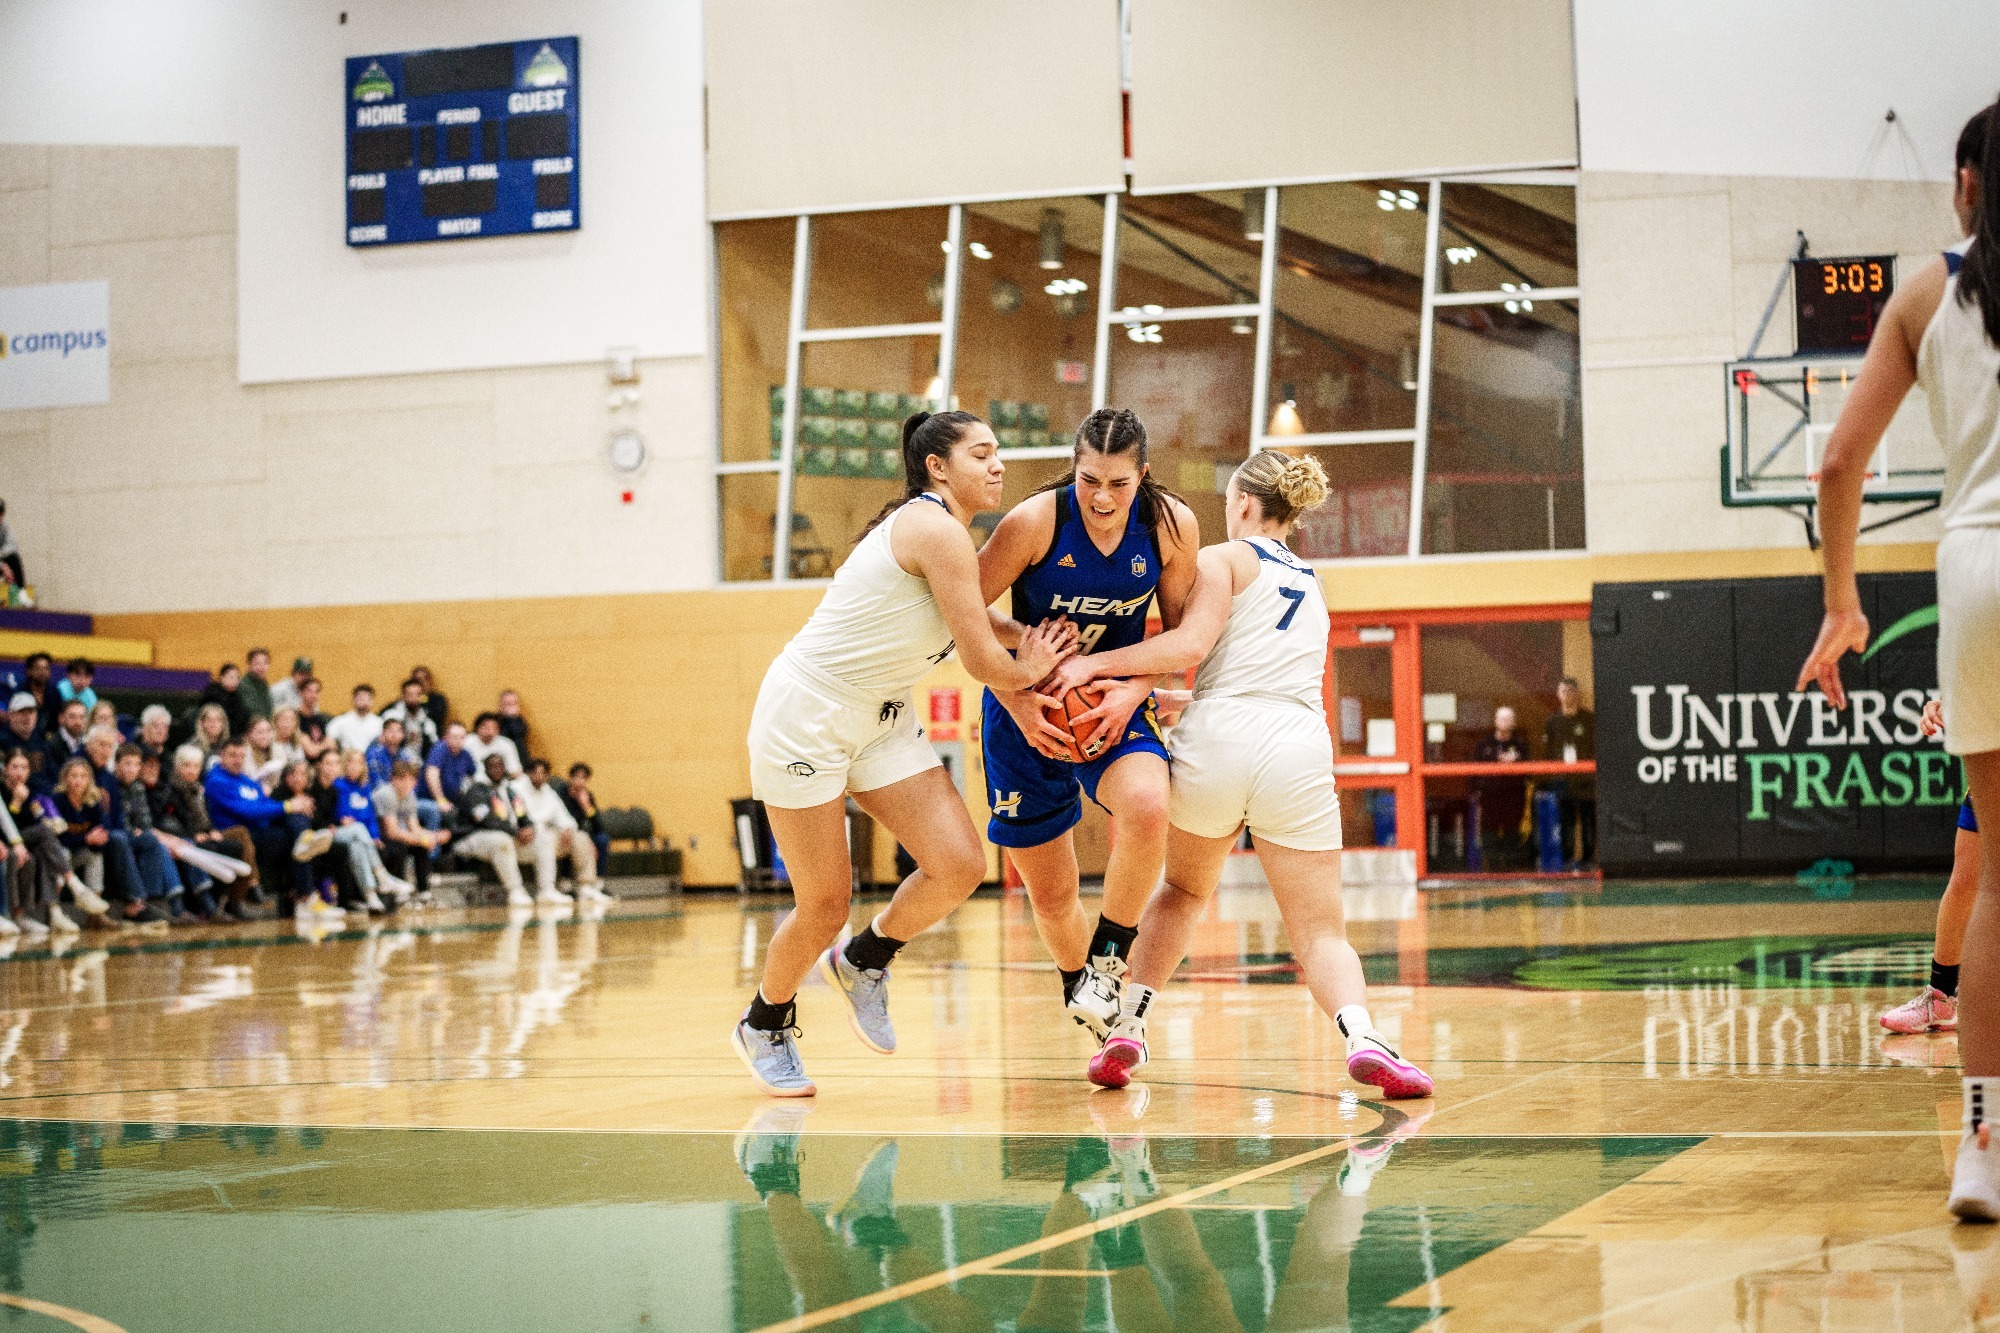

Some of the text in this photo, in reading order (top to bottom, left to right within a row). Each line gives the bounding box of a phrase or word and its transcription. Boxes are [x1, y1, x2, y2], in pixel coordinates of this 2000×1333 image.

[357, 104, 407, 127] HOME
[508, 88, 568, 114] GUEST
[418, 166, 465, 185] PLAYER
[1823, 263, 1884, 295] 3:03
[10, 328, 107, 359] campus
[1050, 593, 1149, 616] HEAT
[1276, 586, 1306, 631] 7
[1631, 684, 1944, 751] UNIVERS
[1638, 751, 1968, 821] OF THE FRASE
